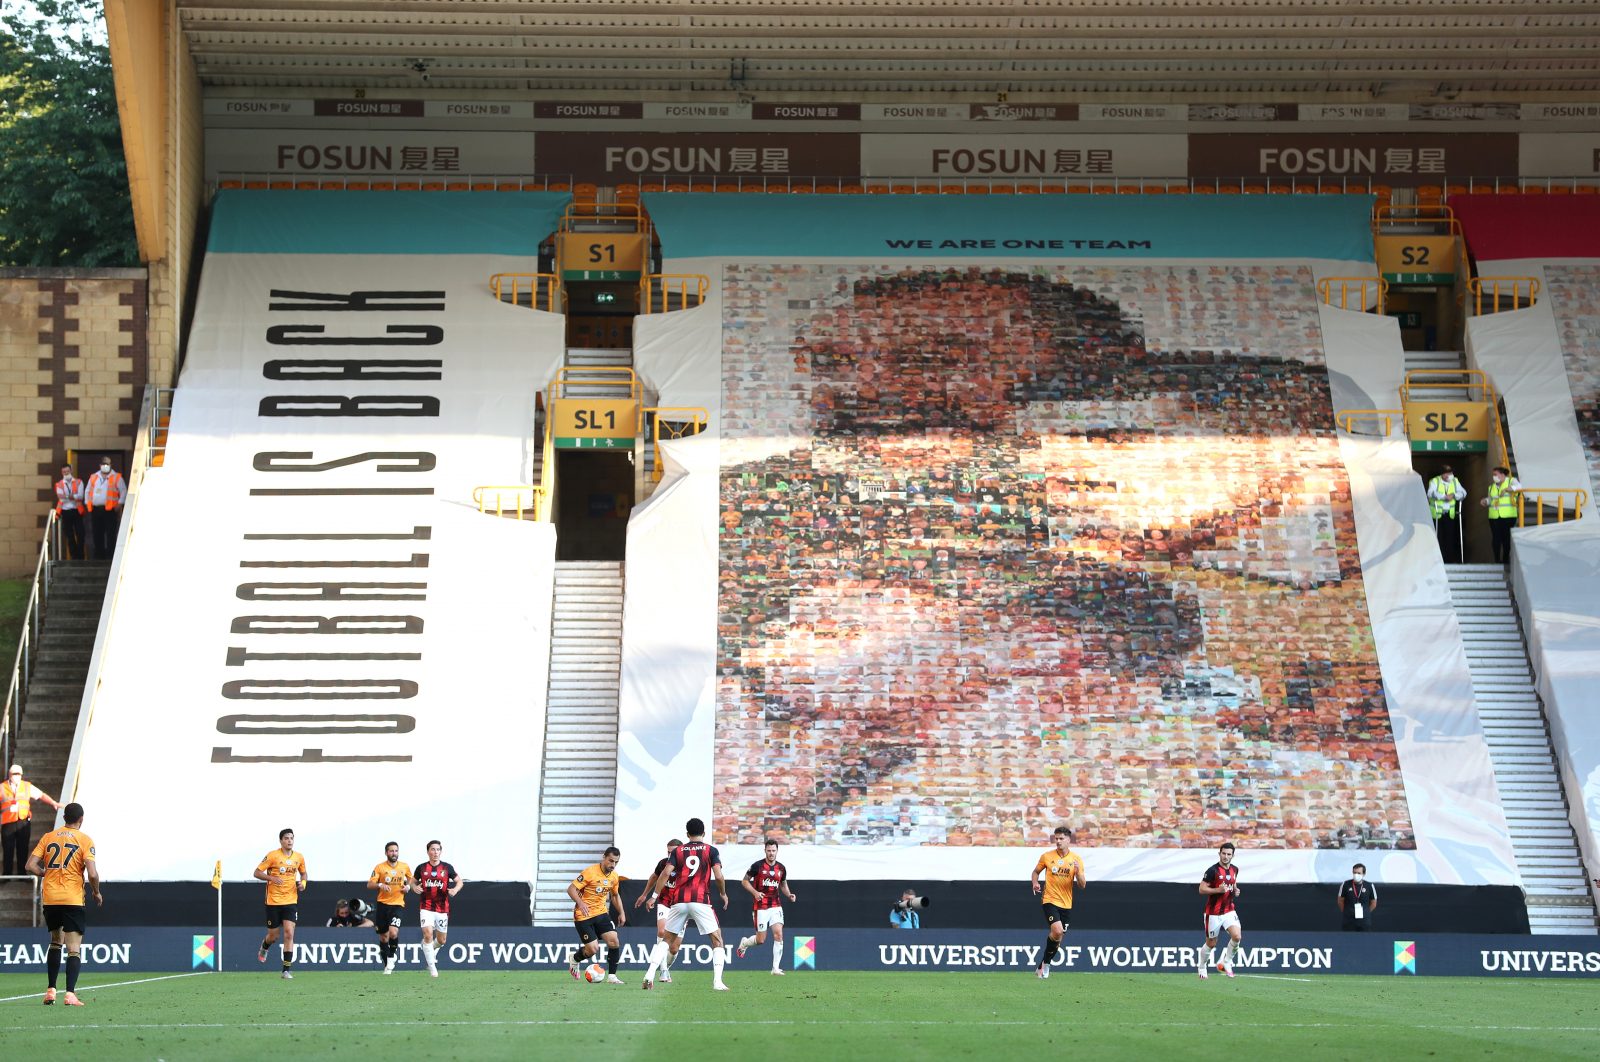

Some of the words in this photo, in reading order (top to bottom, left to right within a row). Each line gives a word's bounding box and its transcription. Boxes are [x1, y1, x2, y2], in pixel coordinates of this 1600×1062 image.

[337, 103, 378, 113] FOSUN
[447, 104, 488, 114] FOSUN
[557, 105, 597, 115] FOSUN
[666, 106, 706, 116] FOSUN
[774, 107, 814, 117] FOSUN
[883, 107, 923, 117] FOSUN
[1101, 107, 1142, 117] FOSUN
[1543, 106, 1585, 116] FOSUN
[277, 145, 392, 169] FOSUN
[400, 145, 460, 171] 复星
[605, 147, 721, 173] FOSUN
[728, 147, 789, 173] 复星
[932, 149, 1046, 174] FOSUN
[1053, 149, 1114, 174] 复星
[1259, 148, 1376, 174] FOSUN
[1383, 148, 1446, 174] 复星
[589, 243, 615, 263] S1
[885, 239, 933, 249] WE
[938, 239, 996, 249] ARE
[1002, 239, 1064, 249] ONE
[1069, 239, 1152, 249] TEAM
[1401, 246, 1430, 267] S2
[258, 289, 446, 416] BACK
[574, 409, 615, 430] SL1
[1425, 412, 1469, 433] SL2
[249, 451, 436, 496] IS
[211, 525, 432, 763] FOOTBALL
[46, 842, 80, 870] 27
[686, 855, 700, 877] 9
[391, 917, 402, 927] 28
[449, 943, 483, 964] OF
[489, 943, 734, 964] WOLVEHAMTON
[879, 944, 1040, 966] UNIVERSITY
[1050, 945, 1082, 966] OF
[1481, 950, 1600, 972] UNIVERS
